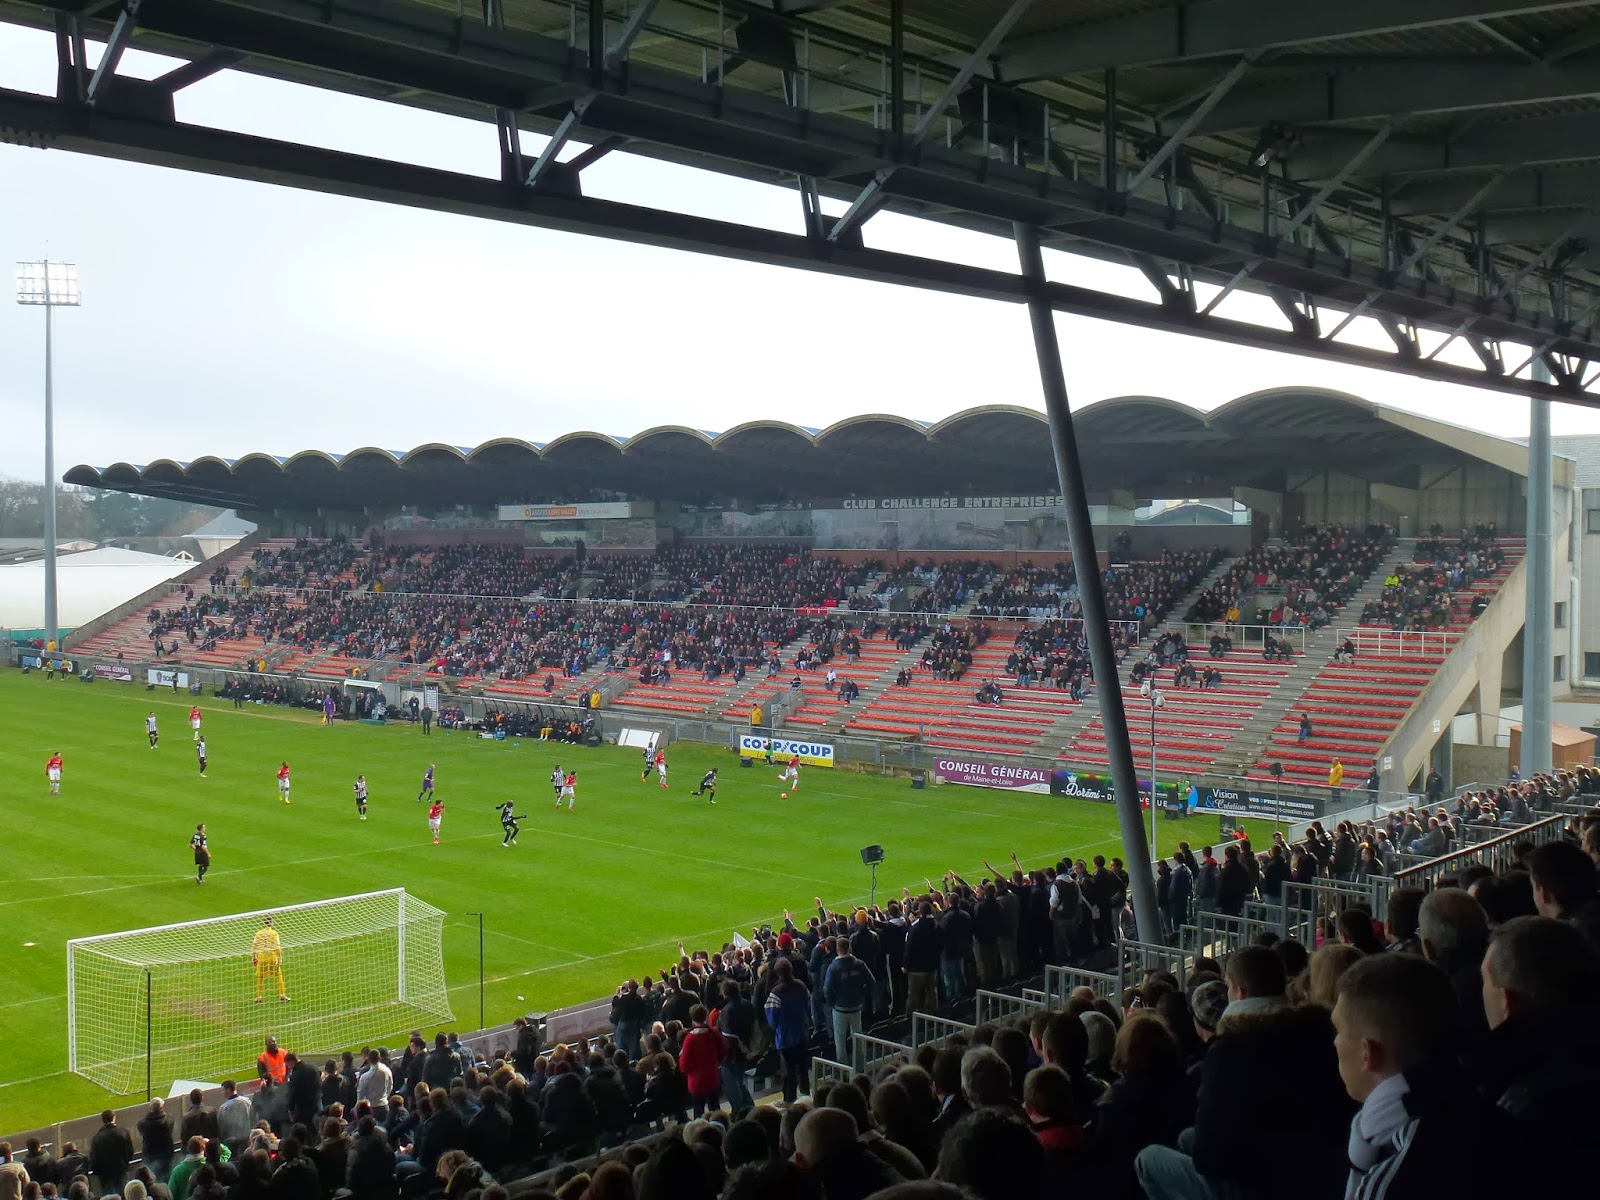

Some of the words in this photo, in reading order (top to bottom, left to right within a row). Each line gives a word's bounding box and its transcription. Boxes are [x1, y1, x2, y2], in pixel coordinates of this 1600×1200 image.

[843, 499, 876, 509] CLUB
[881, 498, 958, 509] CHALLENGE
[964, 496, 1064, 508] ENTREPRISES
[743, 738, 781, 751] COP
[789, 743, 831, 756] COUP
[939, 760, 986, 775] CONSEIL
[991, 766, 1046, 781] GÉNÉRAL
[1212, 788, 1238, 800] Vision
